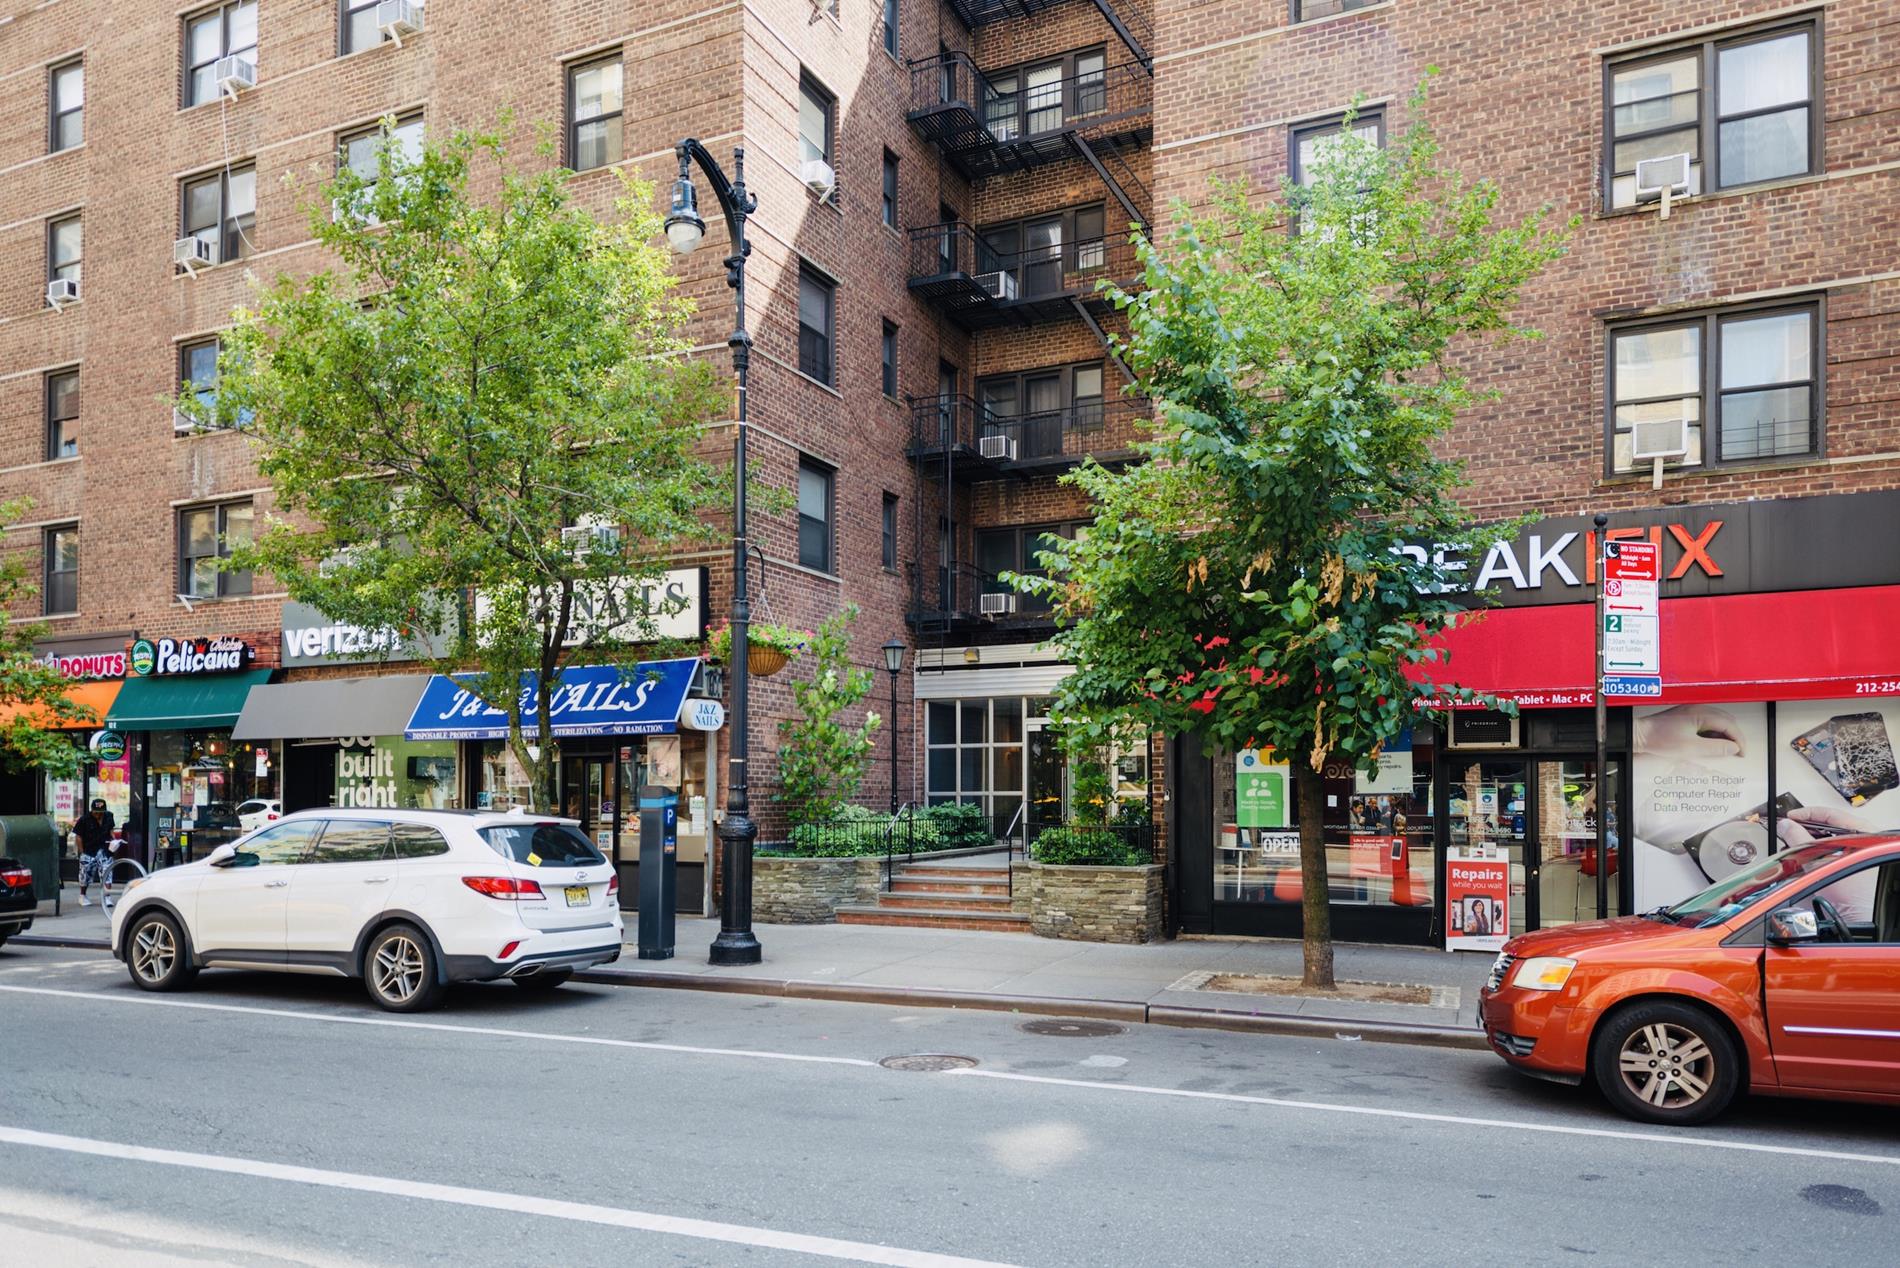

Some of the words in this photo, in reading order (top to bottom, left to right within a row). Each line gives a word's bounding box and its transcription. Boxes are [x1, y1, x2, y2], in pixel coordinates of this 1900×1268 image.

[1609, 616, 1618, 631] 2
[285, 619, 401, 657] verizon
[157, 639, 240, 673] Pelicana
[60, 653, 125, 678] DONUTS
[1605, 683, 1646, 694] 105340
[1513, 695, 1544, 705] Tablet
[1552, 694, 1572, 703] Mac
[1580, 693, 1593, 703] PC
[698, 703, 717, 714] J&Z
[695, 714, 720, 726] NAILS
[412, 731, 448, 740] DISPOSABLE
[450, 730, 477, 739] PRODUCT
[488, 730, 504, 738] HIGH
[554, 727, 603, 736] STERILIZATION
[613, 726, 623, 734] NO
[625, 724, 663, 733] RADIATION
[339, 748, 394, 777] built
[1653, 776, 1672, 785] Cell
[1676, 776, 1709, 785] Phone
[1712, 776, 1745, 786] Repair
[339, 779, 397, 808] right
[1653, 789, 1705, 799] Computer
[1708, 789, 1742, 799] Repair
[1653, 802, 1677, 812] Data
[1681, 803, 1729, 814] Recovery
[667, 809, 674, 824] P
[1263, 838, 1298, 852] OPEN
[1452, 868, 1504, 881] Repairs
